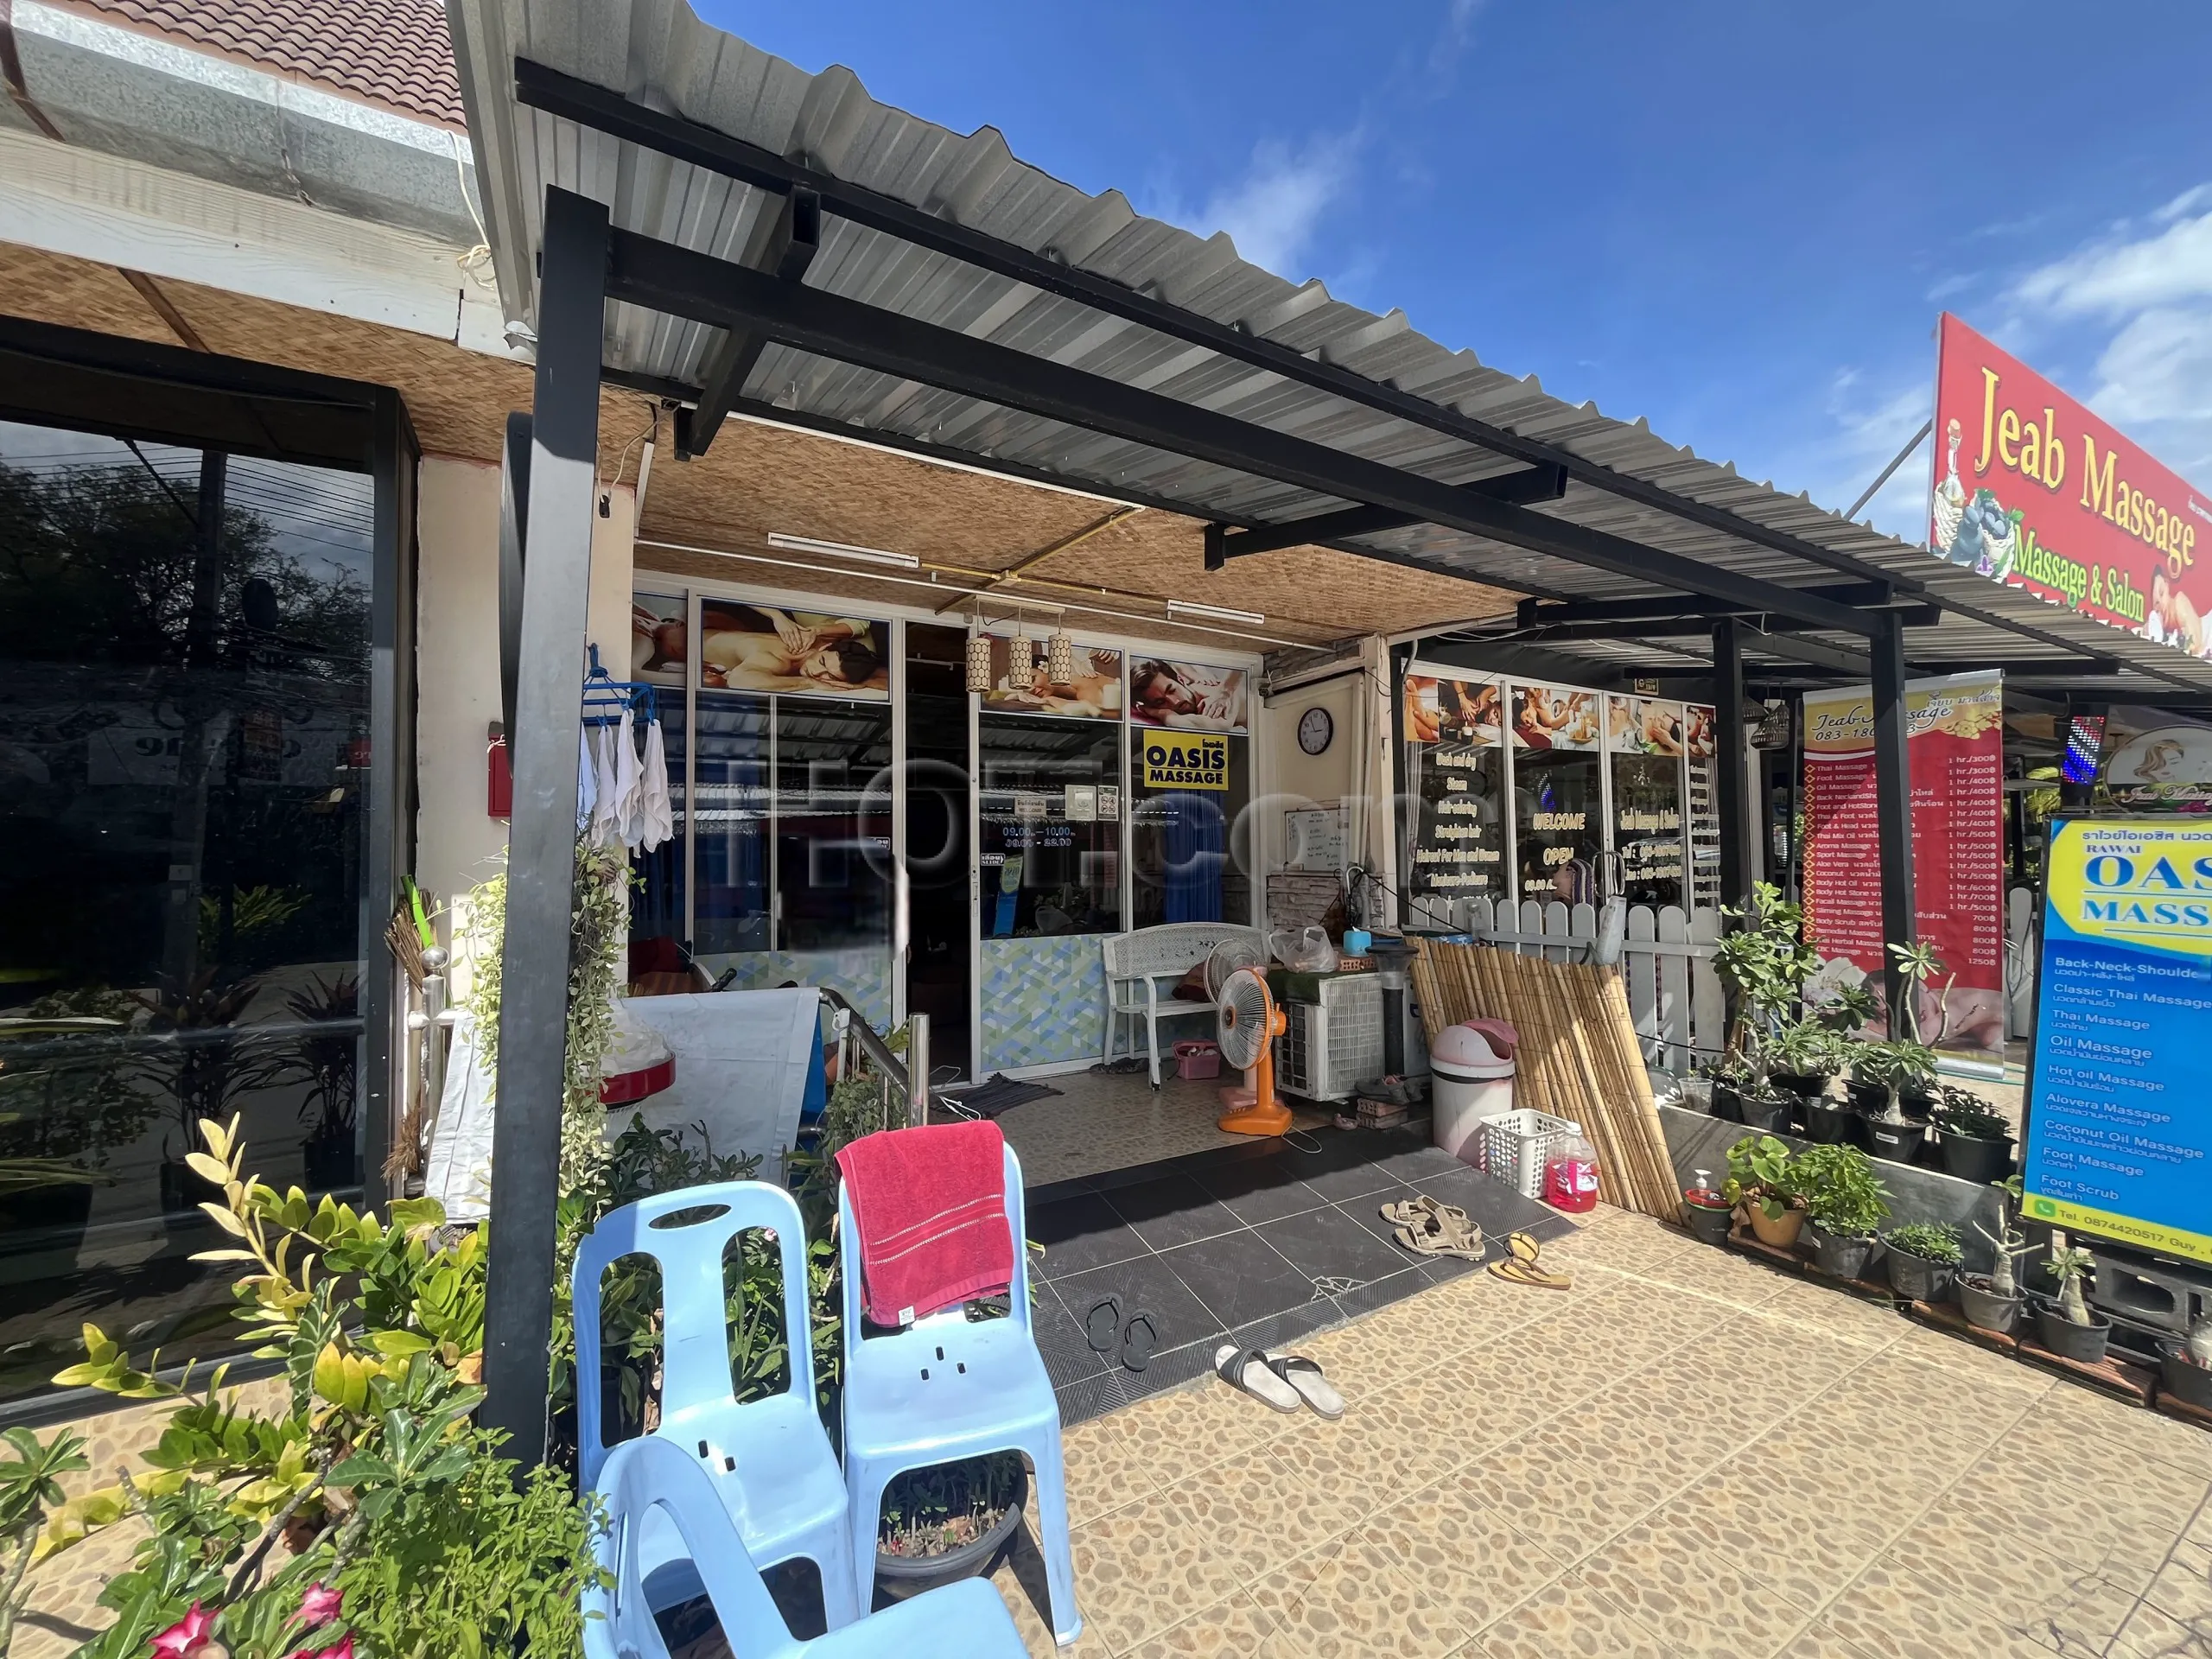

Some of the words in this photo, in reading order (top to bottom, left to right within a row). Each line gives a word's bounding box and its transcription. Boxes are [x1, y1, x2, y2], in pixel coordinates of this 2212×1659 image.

[1974, 366, 2065, 490] Jeab
[2080, 434, 2196, 579] Massage
[2013, 524, 2088, 609] Massage
[2090, 565, 2103, 605] &
[2106, 568, 2145, 623] Salon
[1812, 706, 1863, 730] Jeab
[1147, 746, 1225, 769] OASIS
[1436, 752, 1452, 766] Wash
[1453, 753, 1465, 766] and
[1465, 753, 1476, 772] dry
[1150, 770, 1223, 785] MASSAGE
[1446, 777, 1467, 791] Steam
[1469, 823, 1482, 838] hair
[1533, 813, 1586, 830] WELCOME
[1416, 849, 1441, 862] Haircut
[1441, 849, 1452, 862] For
[1453, 849, 1466, 862] Men
[1467, 847, 1478, 861] and
[1479, 849, 1500, 861] Women
[1543, 848, 1574, 865] OPEN
[2086, 844, 2141, 854] RAWAI
[2085, 855, 2212, 891] OAS
[2082, 899, 2209, 927] MASS
[1856, 939, 1884, 948] Massag
[2055, 957, 2210, 980] Back-Neck-Shoulde
[2053, 983, 2103, 996] Classic
[2107, 988, 2139, 1001] Thai
[2143, 992, 2212, 1010] Massage
[2052, 1009, 2081, 1021] Thai
[2085, 1014, 2151, 1030] Massage
[2050, 1035, 2072, 1047] Oil
[2077, 1039, 2152, 1059] Massage
[2049, 1065, 2073, 1077] Hot
[2077, 1070, 2093, 1079] oil
[2098, 1072, 2164, 1091] Massage
[2046, 1093, 2099, 1109] Alovera
[2103, 1103, 2171, 1123] Massage
[2044, 1120, 2105, 1139] Coconut
[2108, 1132, 2129, 1144] Oil
[2134, 1137, 2204, 1159] Massage
[2043, 1147, 2074, 1161] Foot
[2079, 1154, 2144, 1176] Massage
[2041, 1175, 2072, 1189] Foot
[2077, 1183, 2119, 1199] Scrub
[2060, 1210, 2080, 1222] Tel.
[2084, 1217, 2164, 1242] 0874420517
[2169, 1237, 2196, 1251] Guy
